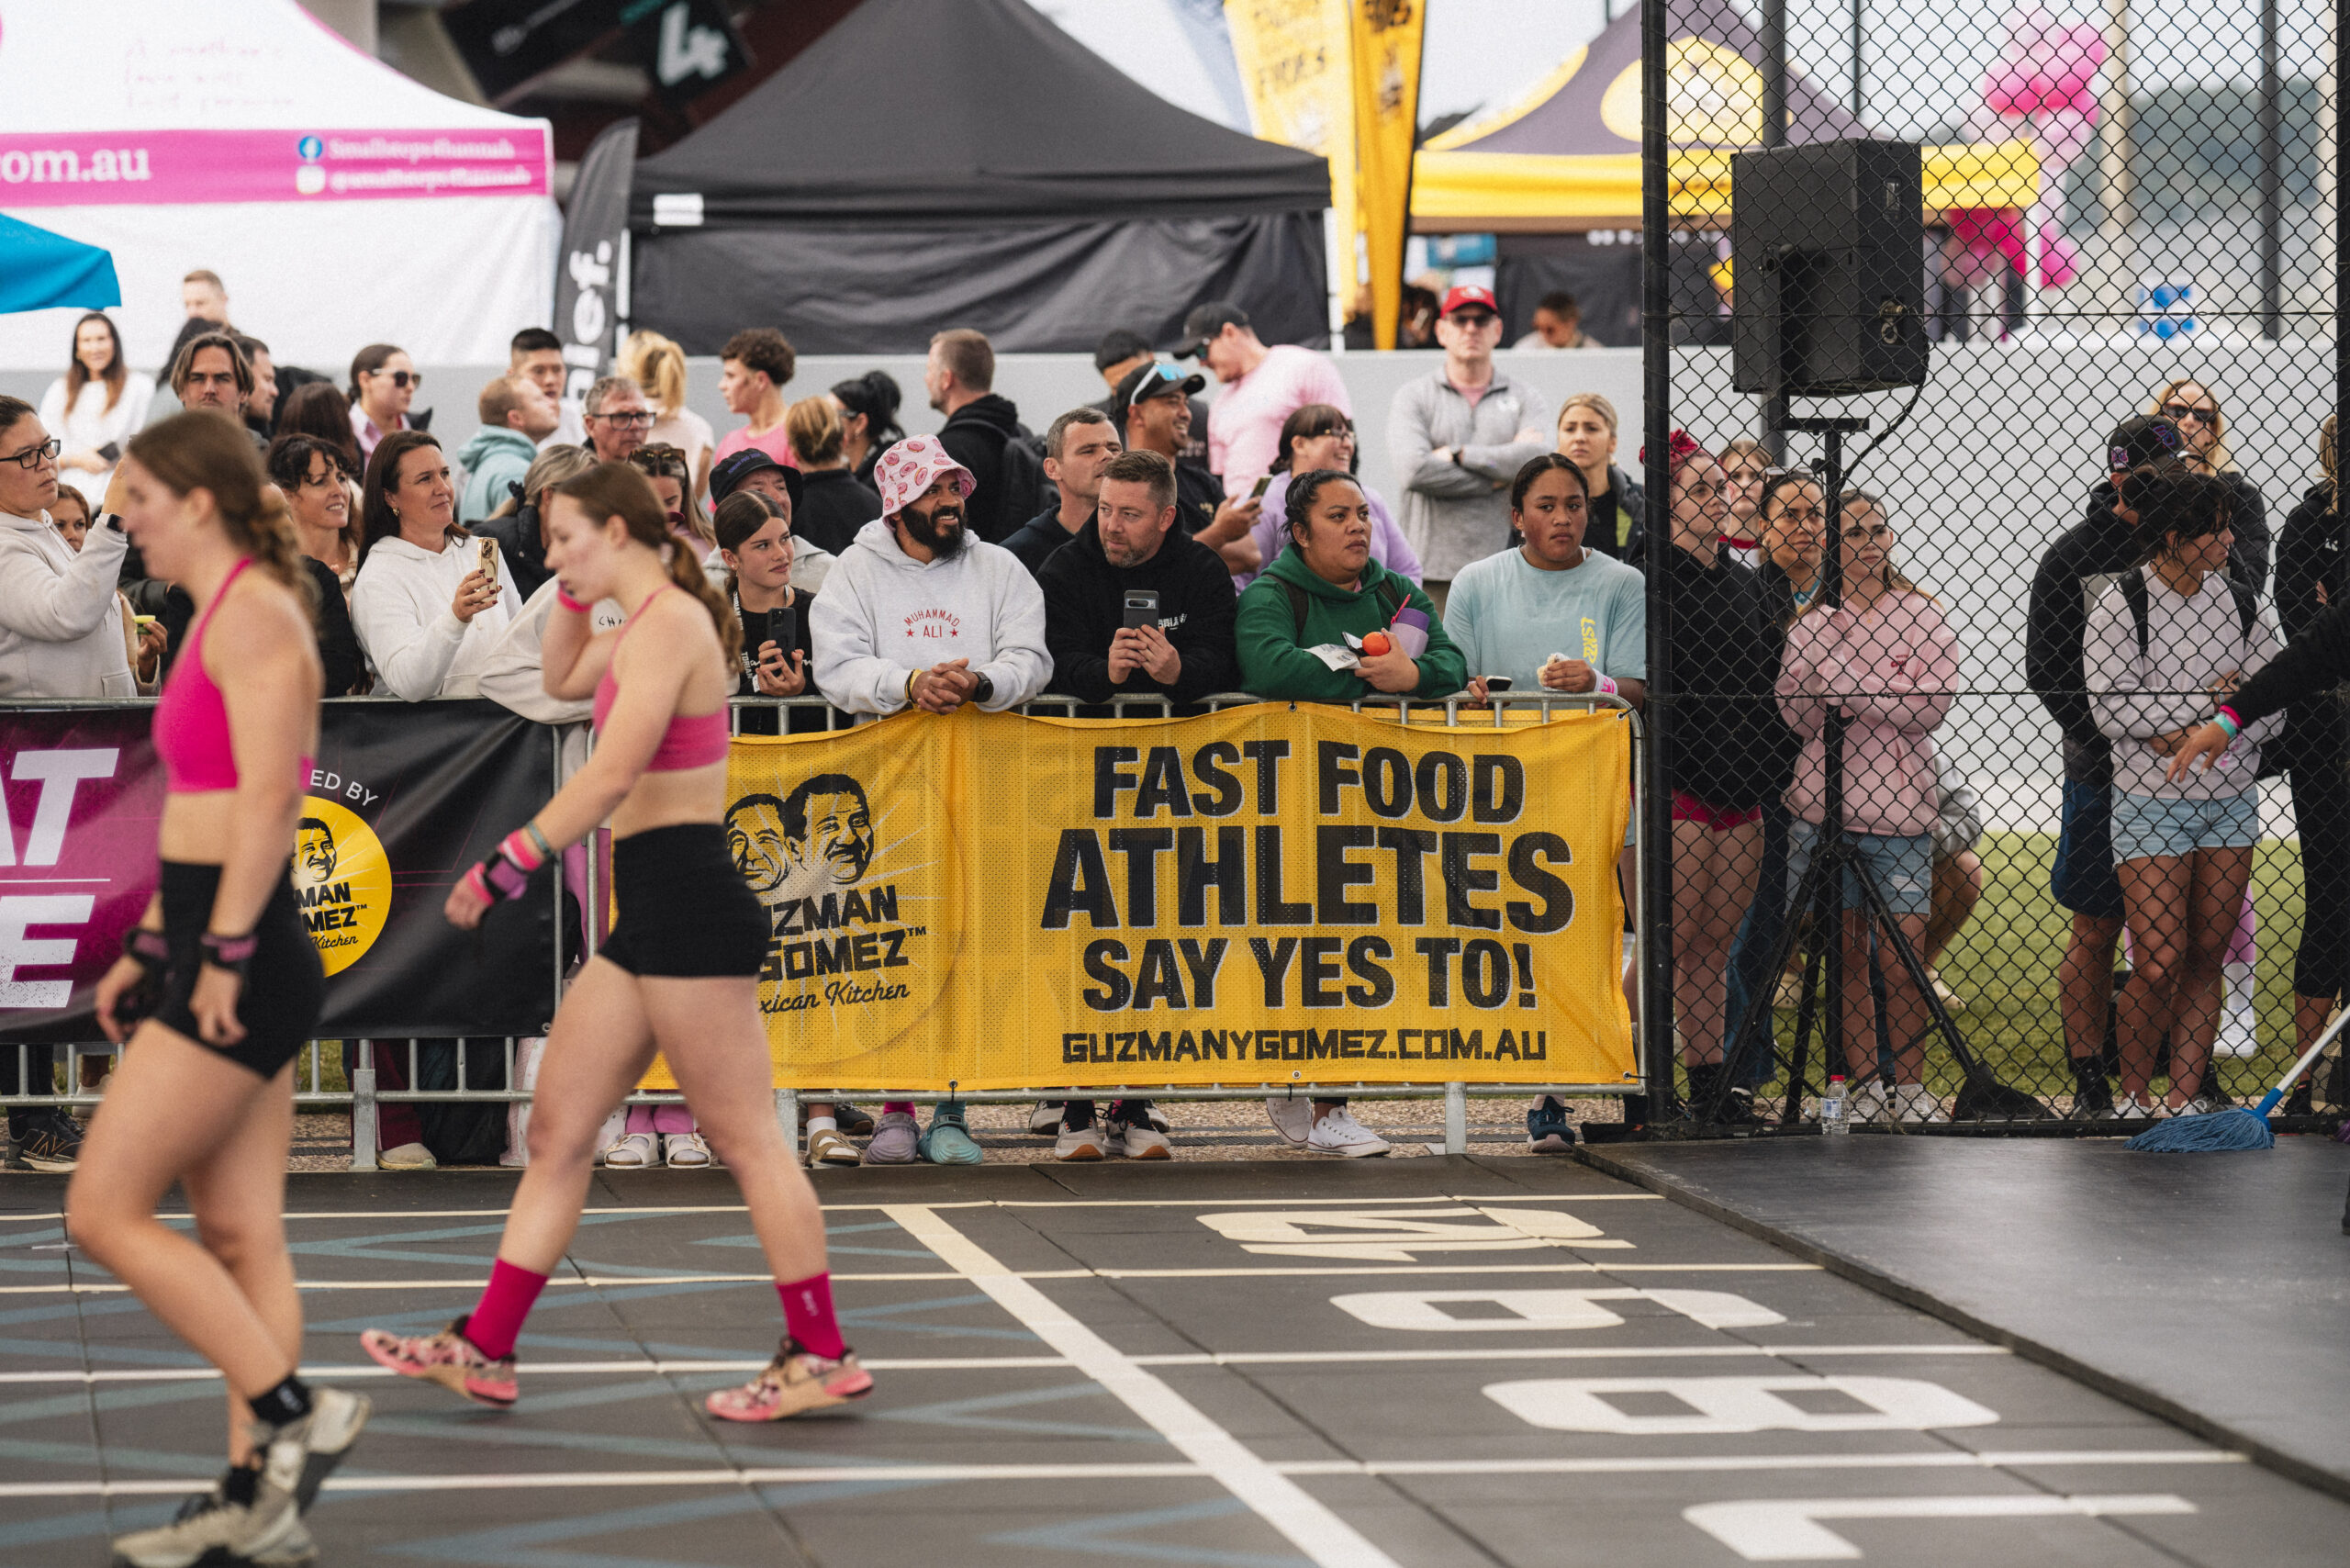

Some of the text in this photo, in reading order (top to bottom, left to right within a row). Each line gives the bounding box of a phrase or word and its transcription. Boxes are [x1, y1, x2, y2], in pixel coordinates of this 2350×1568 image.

[0, 148, 152, 184] om.au
[599, 616, 628, 627] CHI
[903, 609, 960, 627] MUHAMMAD
[923, 624, 943, 638] ALI
[309, 769, 379, 807] ED BY
[1094, 740, 1527, 823] FAST FOOD
[296, 882, 351, 908] MAN
[1041, 825, 1574, 935] ATHLETES
[1082, 935, 1538, 1012] SAY YES TO!
[759, 980, 911, 1014] xican Kitchen
[1062, 1028, 1547, 1064] GUZMANYGOMEZ.COM.AU
[1481, 1375, 2000, 1434] 8
